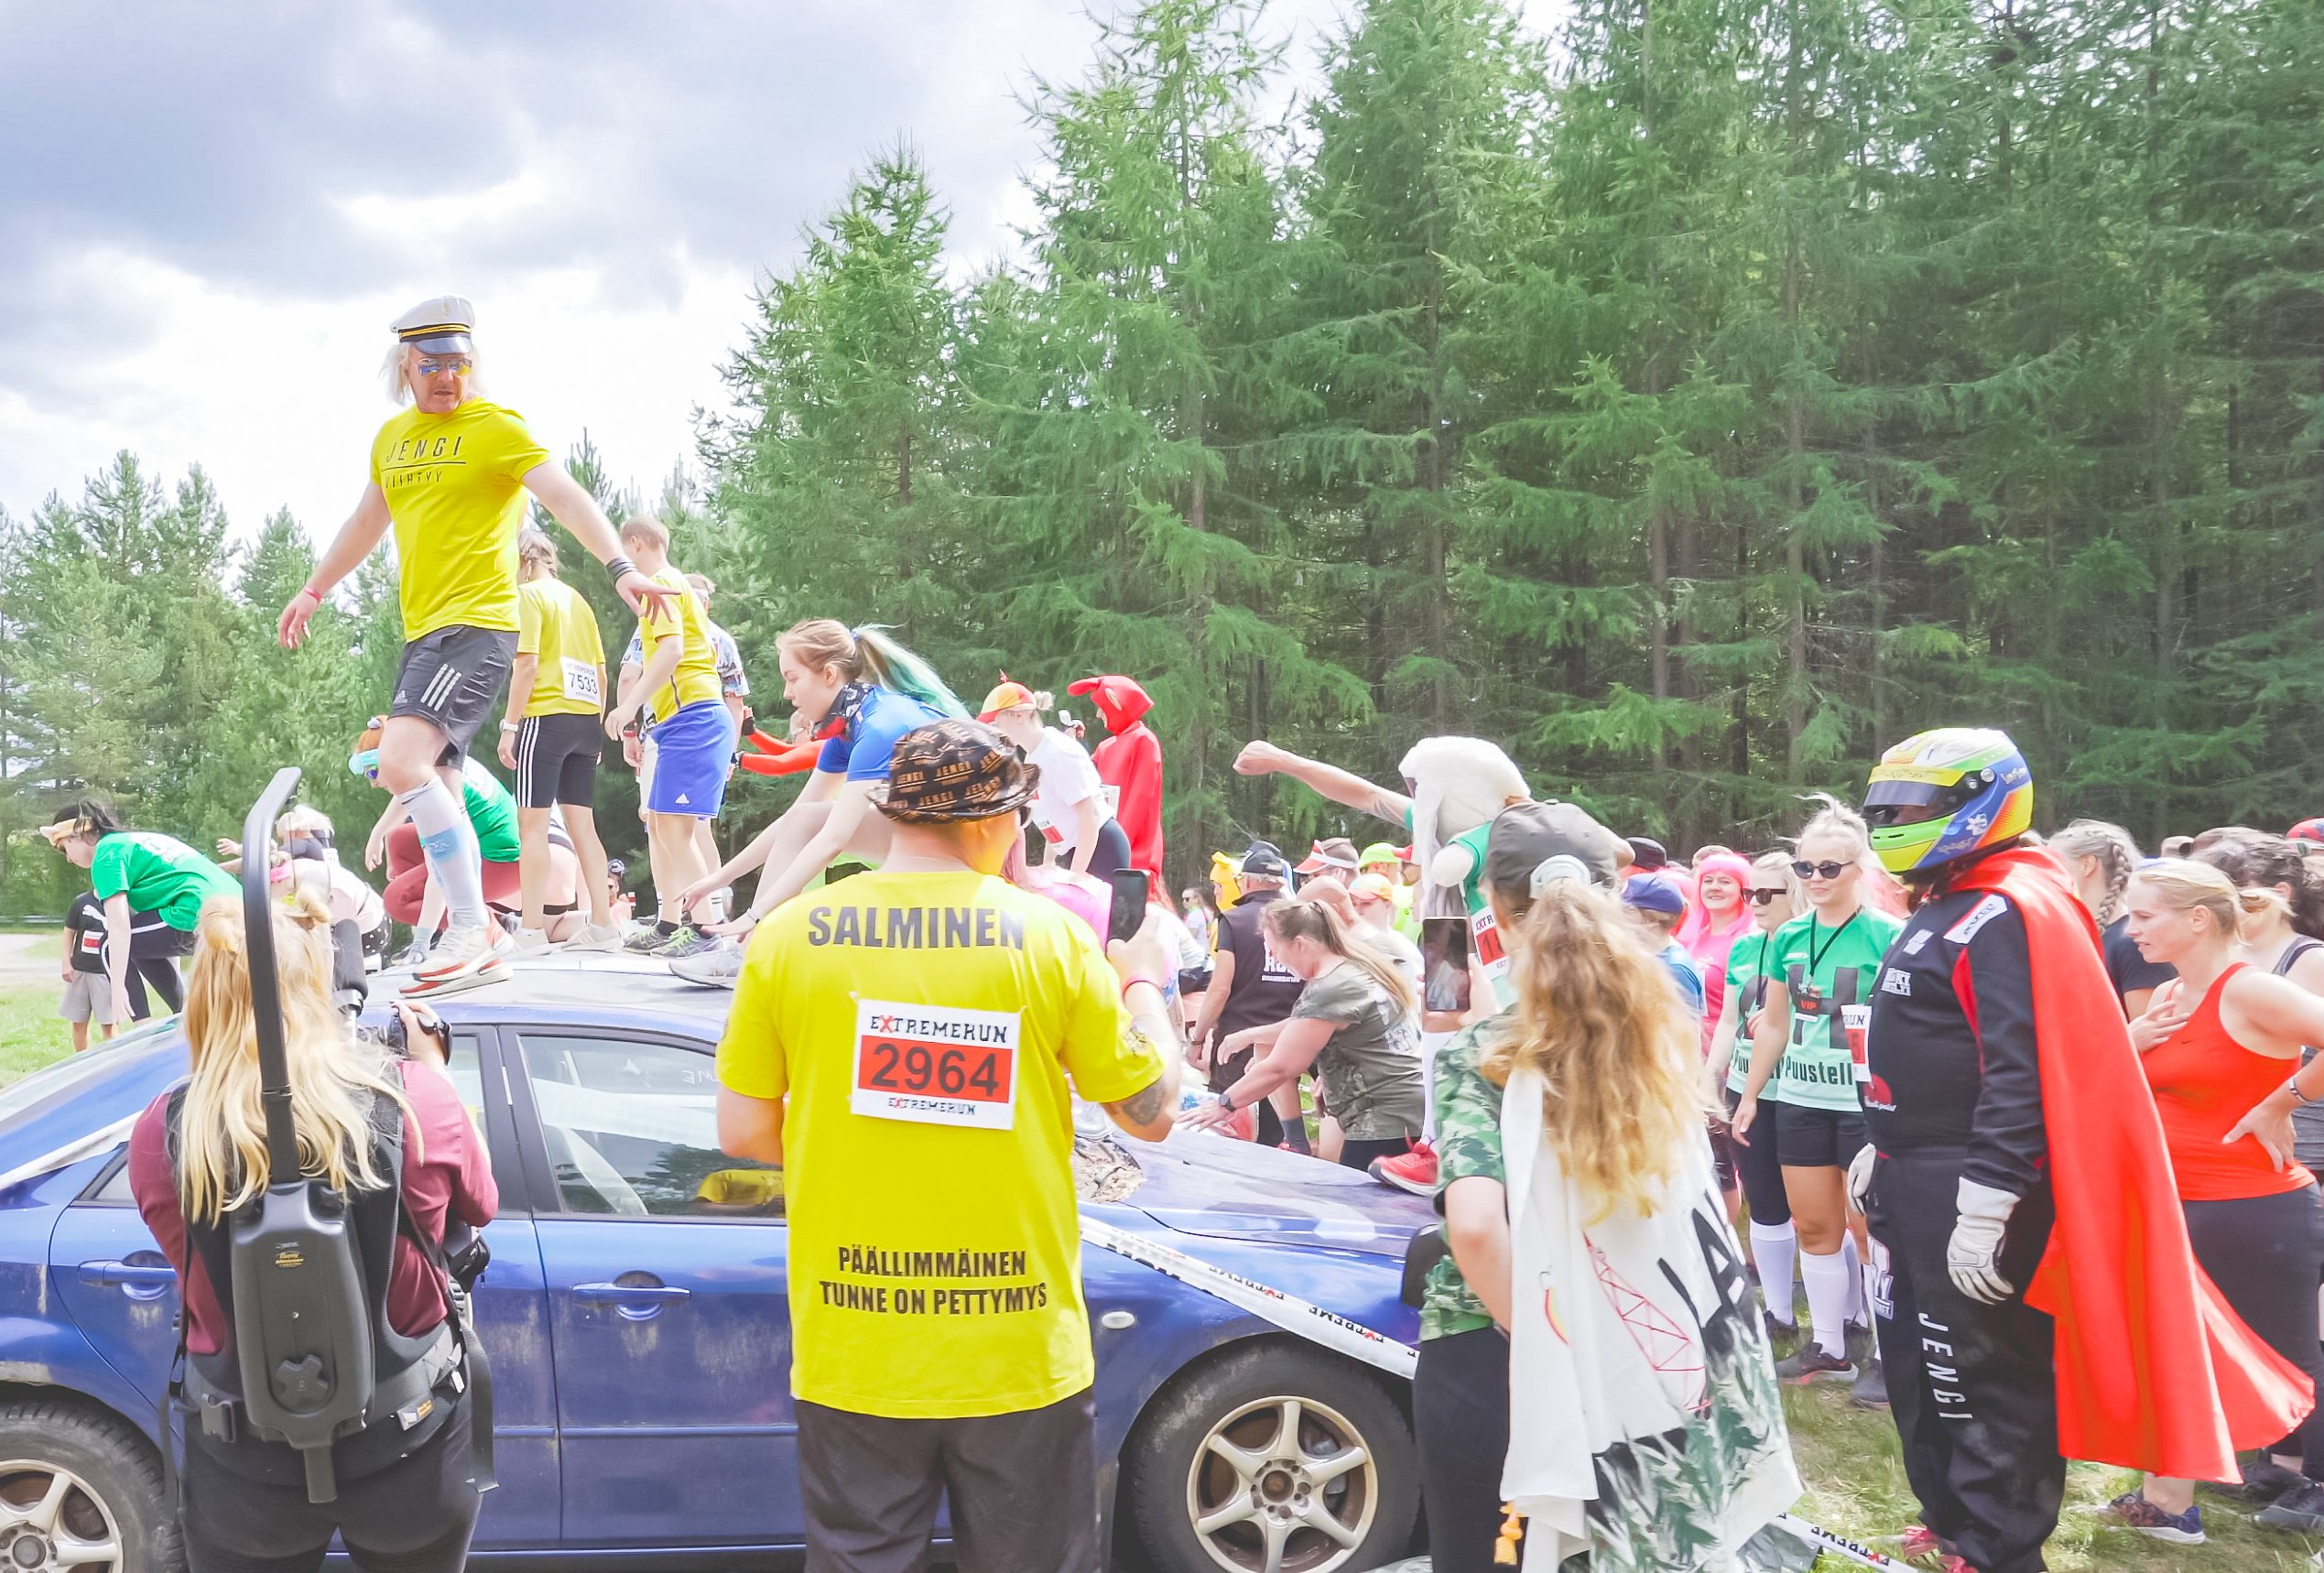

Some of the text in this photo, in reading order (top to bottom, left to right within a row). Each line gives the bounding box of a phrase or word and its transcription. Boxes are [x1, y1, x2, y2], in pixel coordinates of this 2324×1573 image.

[386, 436, 462, 462] JENGI
[568, 672, 597, 694] 7533
[809, 906, 1025, 950] SALMINEN
[871, 1015, 1007, 1043] EXTREMERUN
[871, 1043, 999, 1097] 2964
[1785, 1055, 1853, 1086] Puustell
[888, 1098, 976, 1115] EXTREMERUN
[838, 1243, 1026, 1277] PÄÄLLIMMÄINEN
[819, 1280, 1048, 1315] TUNNE ON PETTYMYS
[1918, 1312, 1973, 1419] JENGI
